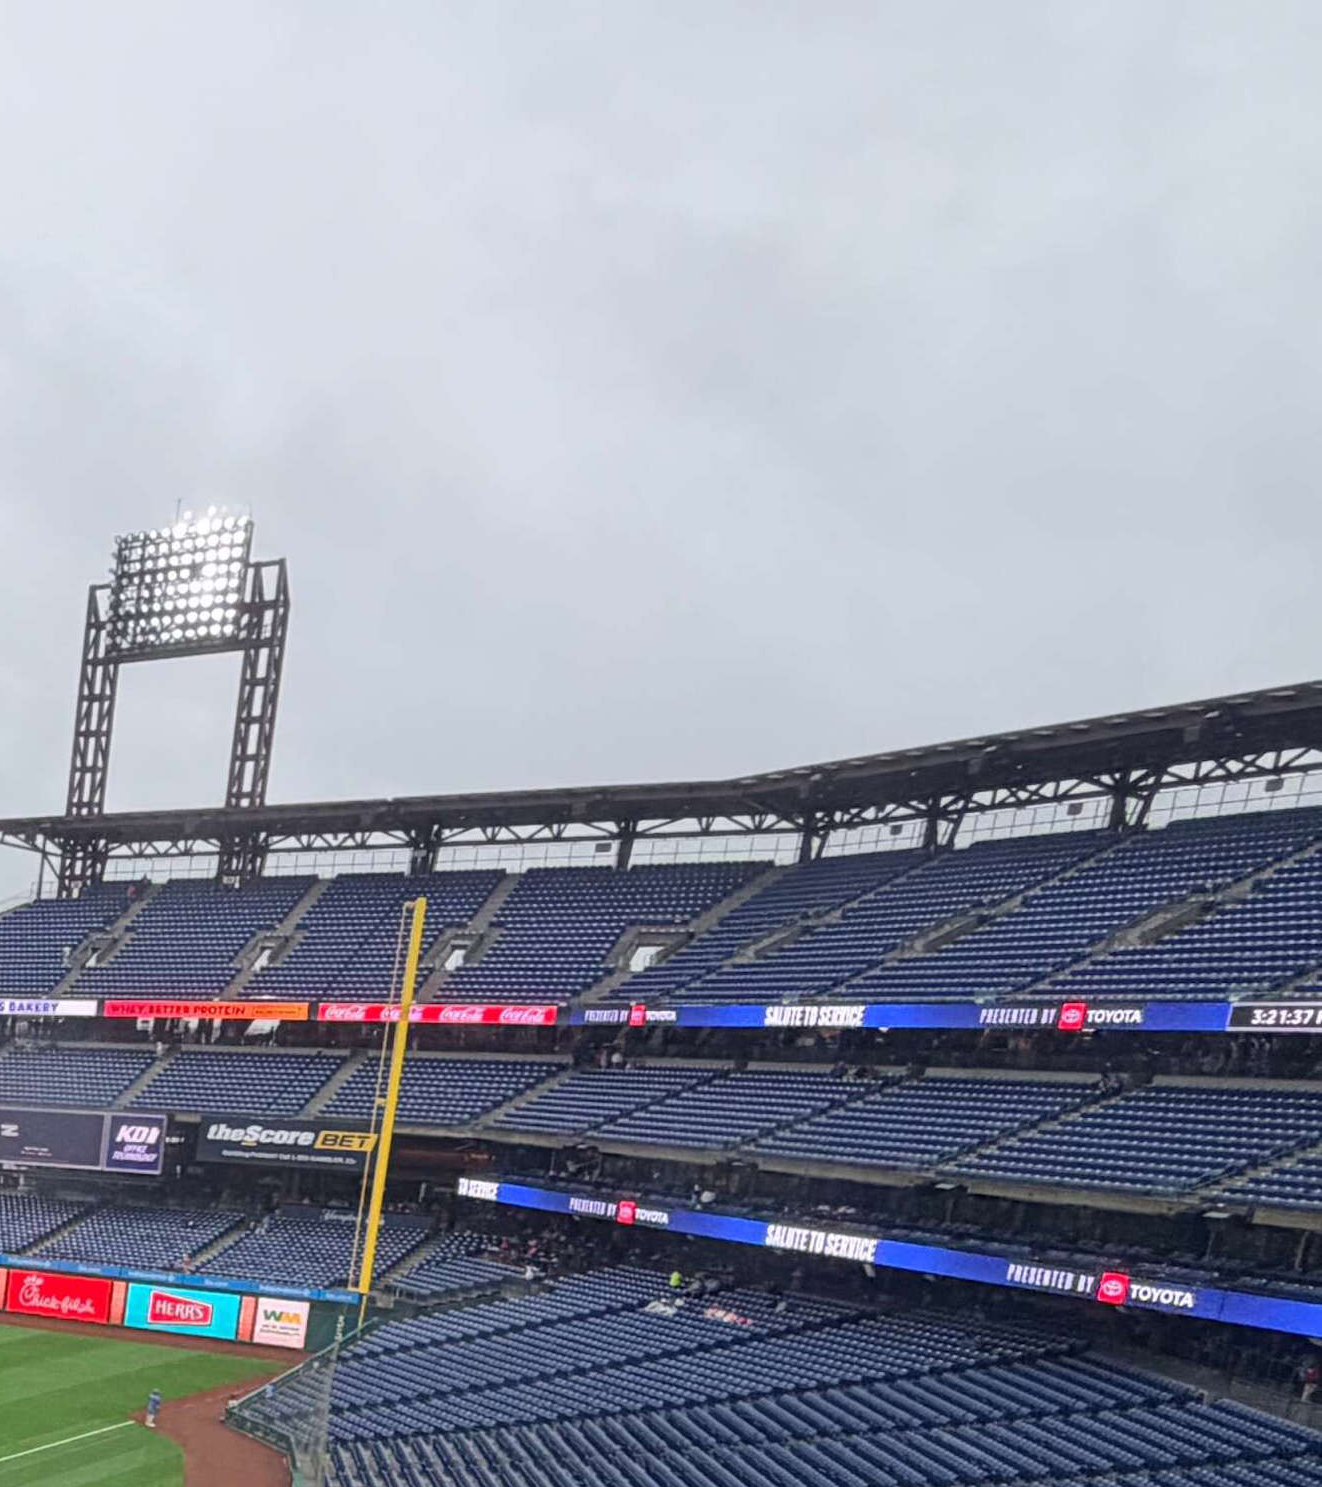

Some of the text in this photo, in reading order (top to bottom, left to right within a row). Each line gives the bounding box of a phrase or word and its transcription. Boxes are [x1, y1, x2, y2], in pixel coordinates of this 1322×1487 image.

[8, 1000, 58, 1012] BAKERY
[194, 1005, 245, 1015] PROTEIN
[765, 1006, 866, 1026] SALUTE TO SERVICE
[979, 1009, 1056, 1024] PRESENTED BY
[1086, 1010, 1142, 1023] TOYOTA
[1251, 1009, 1314, 1025] 3:21:37
[207, 1124, 315, 1146] theScore
[322, 1134, 371, 1149] BET
[469, 1179, 500, 1201] SERVICE
[635, 1208, 669, 1224] TOYOTA
[765, 1224, 877, 1263] SALUTE TO SERVICE
[1007, 1264, 1095, 1293] PRESENTED BY
[1130, 1284, 1194, 1308] TOYOTA
[155, 1300, 204, 1320] HERR'S
[263, 1309, 302, 1325] WM
